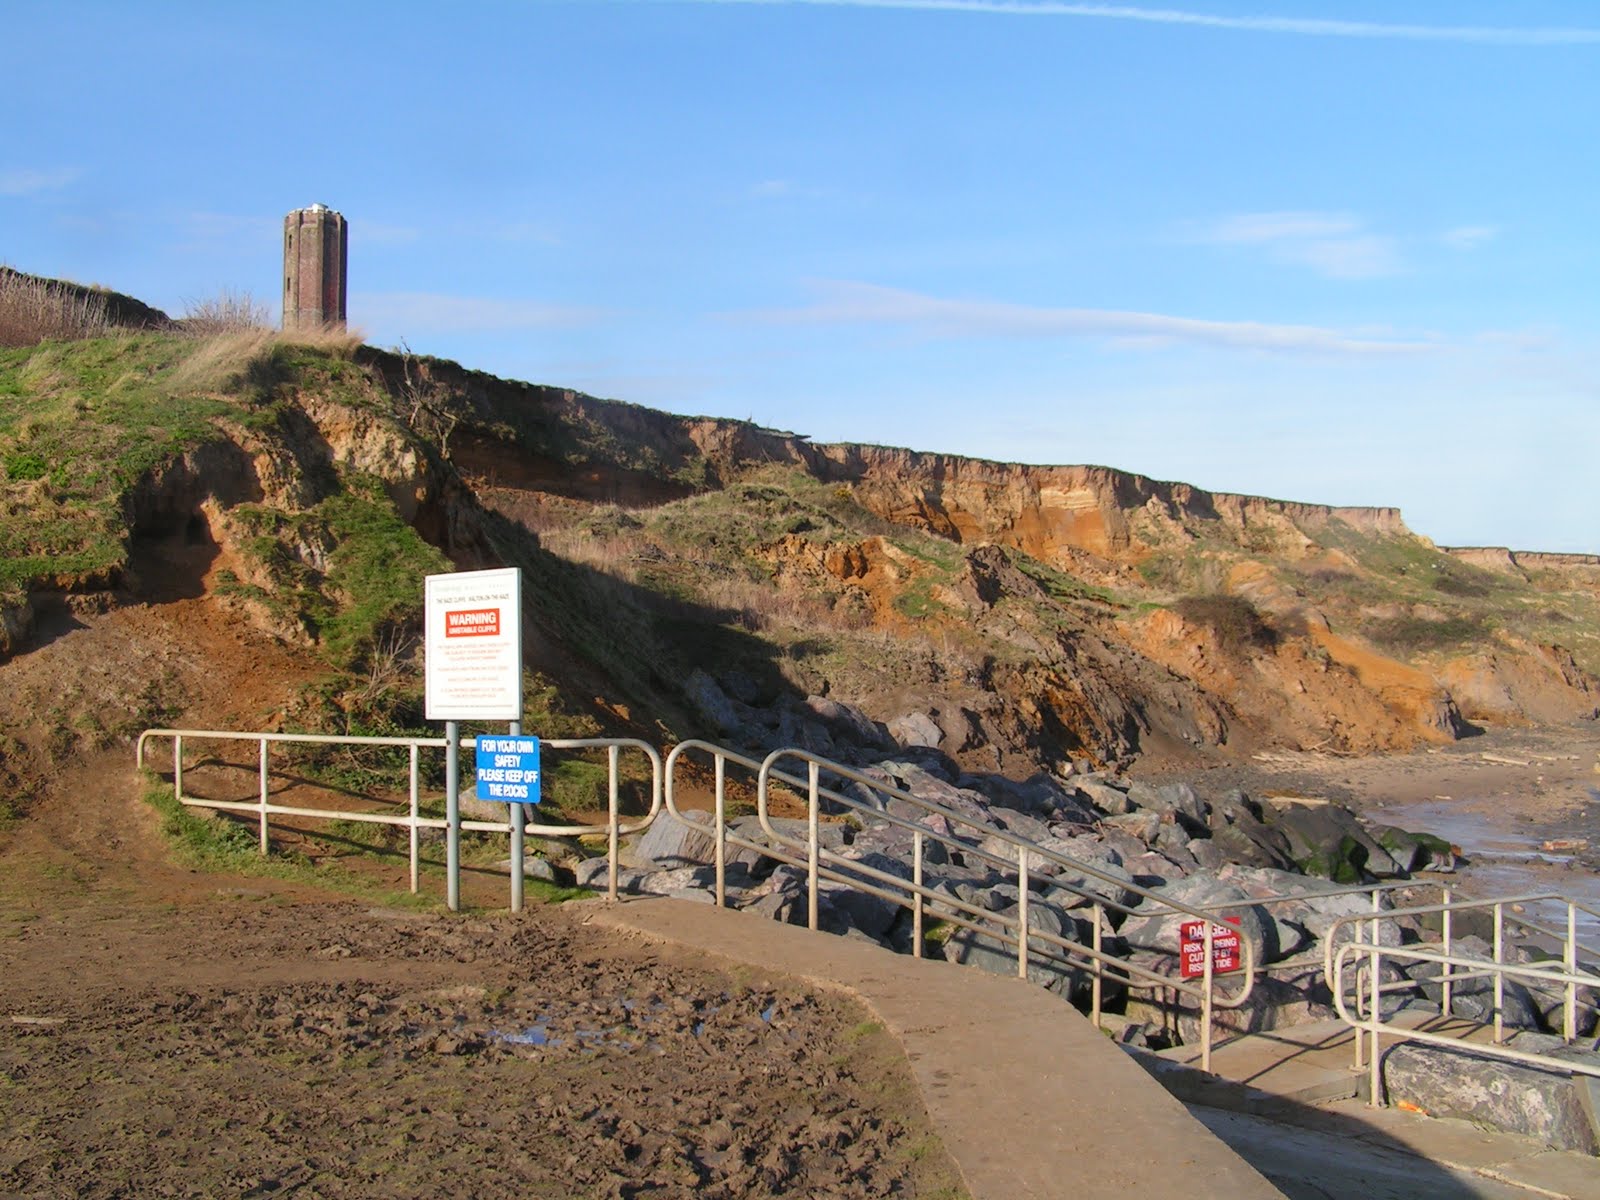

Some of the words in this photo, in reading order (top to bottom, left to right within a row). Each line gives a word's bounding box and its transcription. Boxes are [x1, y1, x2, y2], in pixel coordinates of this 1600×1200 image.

[449, 612, 496, 626] WARNING
[448, 626, 477, 634] UNSTABLE
[478, 625, 496, 633] CLIFFS
[482, 739, 496, 752] FOR
[497, 740, 516, 753] YOUR
[517, 740, 534, 753] OWN
[494, 754, 521, 767] SAFETY
[478, 768, 504, 782] PLEASE
[505, 770, 523, 782] KEEP
[524, 770, 538, 783] OFF
[489, 783, 502, 796] THE
[504, 784, 528, 798] ROCKS
[1189, 923, 1232, 940] DAGE
[1184, 943, 1201, 953] RISK
[1214, 937, 1237, 948] BEING
[1188, 952, 1204, 963] CUT
[1221, 948, 1231, 958] BY
[1215, 958, 1232, 968] TIDE
